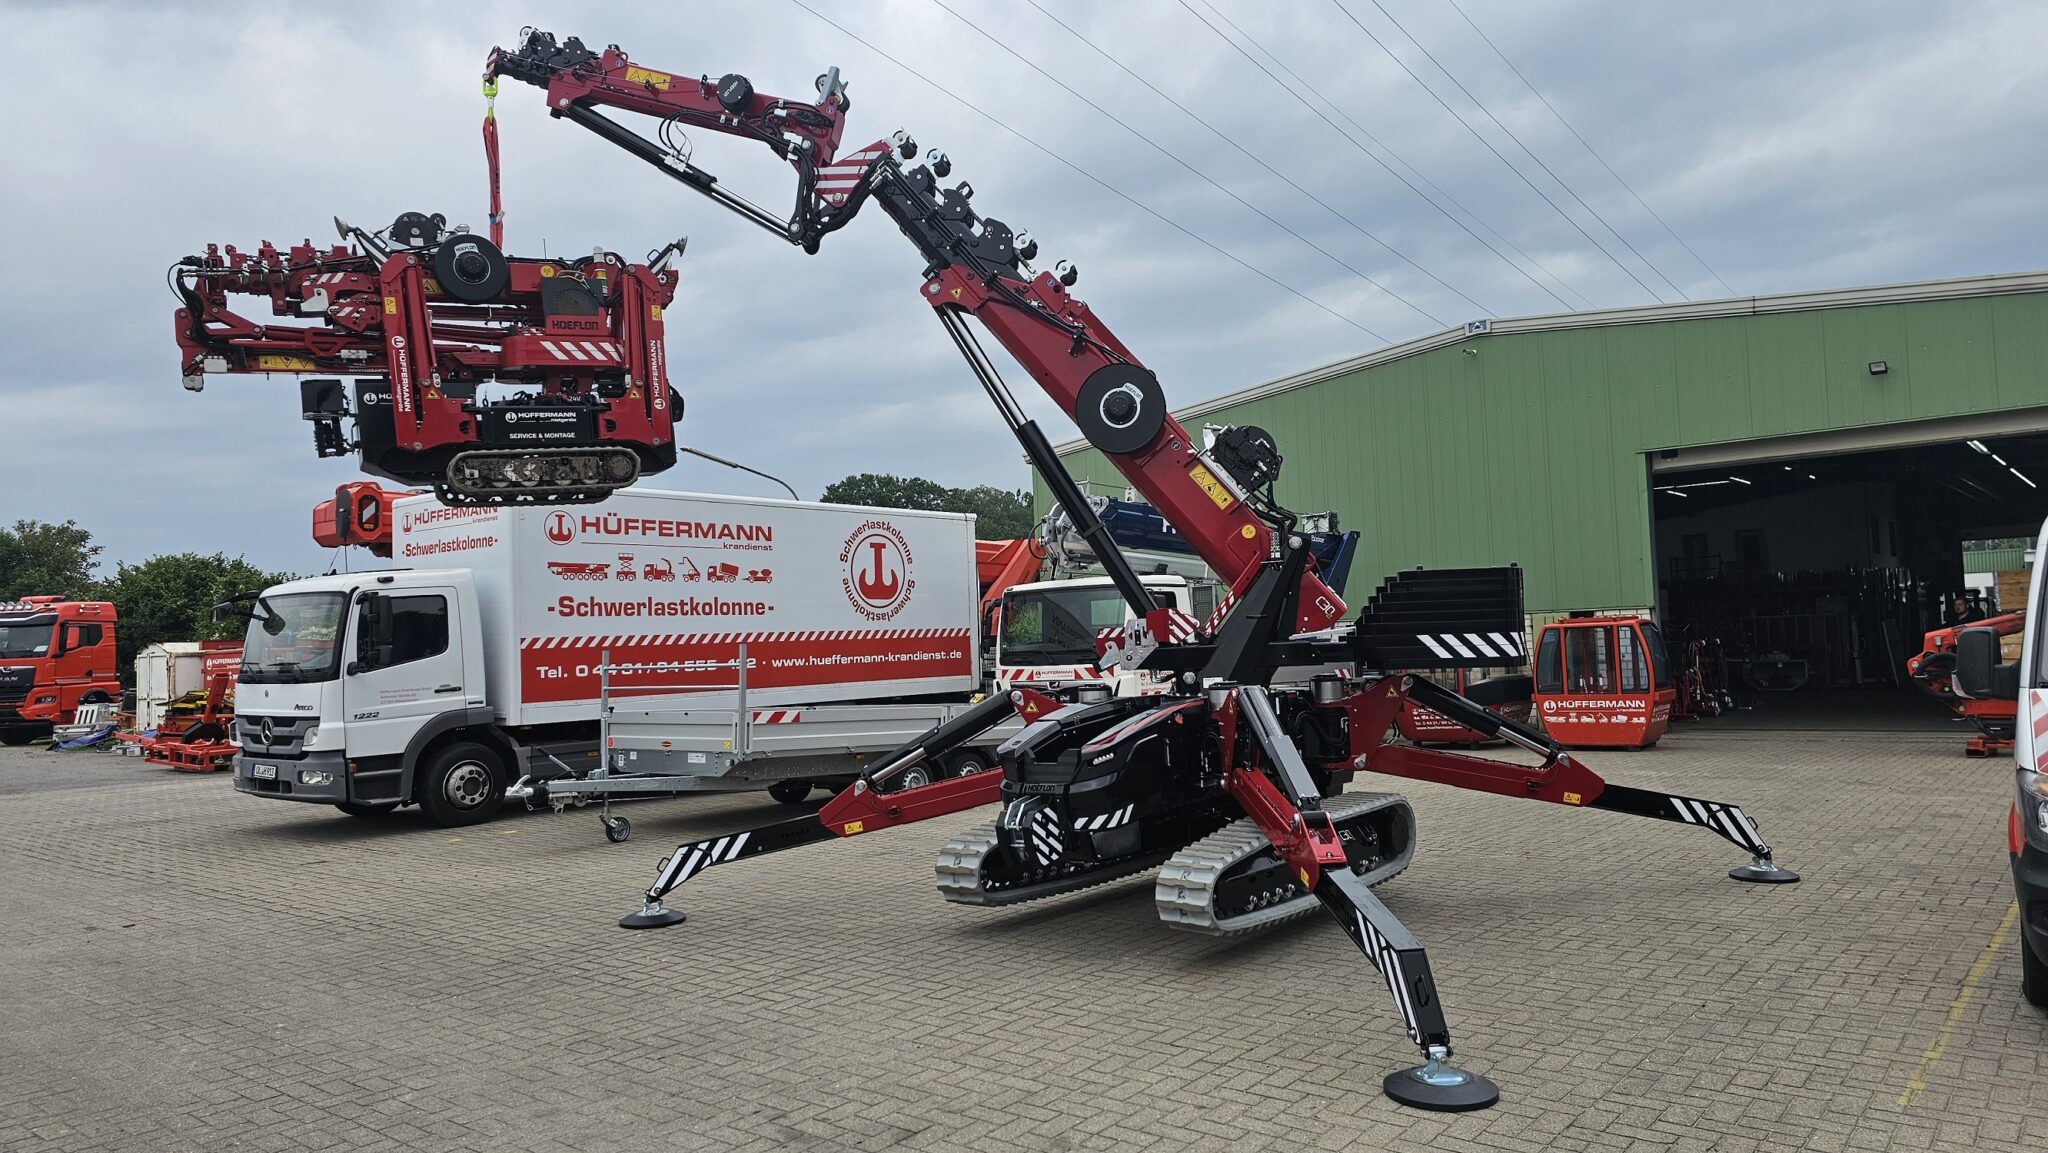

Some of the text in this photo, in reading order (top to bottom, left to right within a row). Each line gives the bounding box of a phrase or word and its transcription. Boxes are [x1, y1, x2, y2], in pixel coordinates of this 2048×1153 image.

[552, 320, 599, 331] HOEFLON
[414, 506, 498, 526] HÜFFERMANN
[581, 512, 773, 542] HÜFFERMANN
[722, 541, 774, 551] krandienst
[839, 519, 913, 565] Schwerlastkolonne
[842, 576, 916, 622] Schwerlastkolonne
[536, 665, 568, 679] Tel.
[771, 649, 962, 668] www.hueffermann-krandienst.de
[1557, 699, 1646, 708] HÜFFERMANN
[353, 711, 380, 720] 1222
